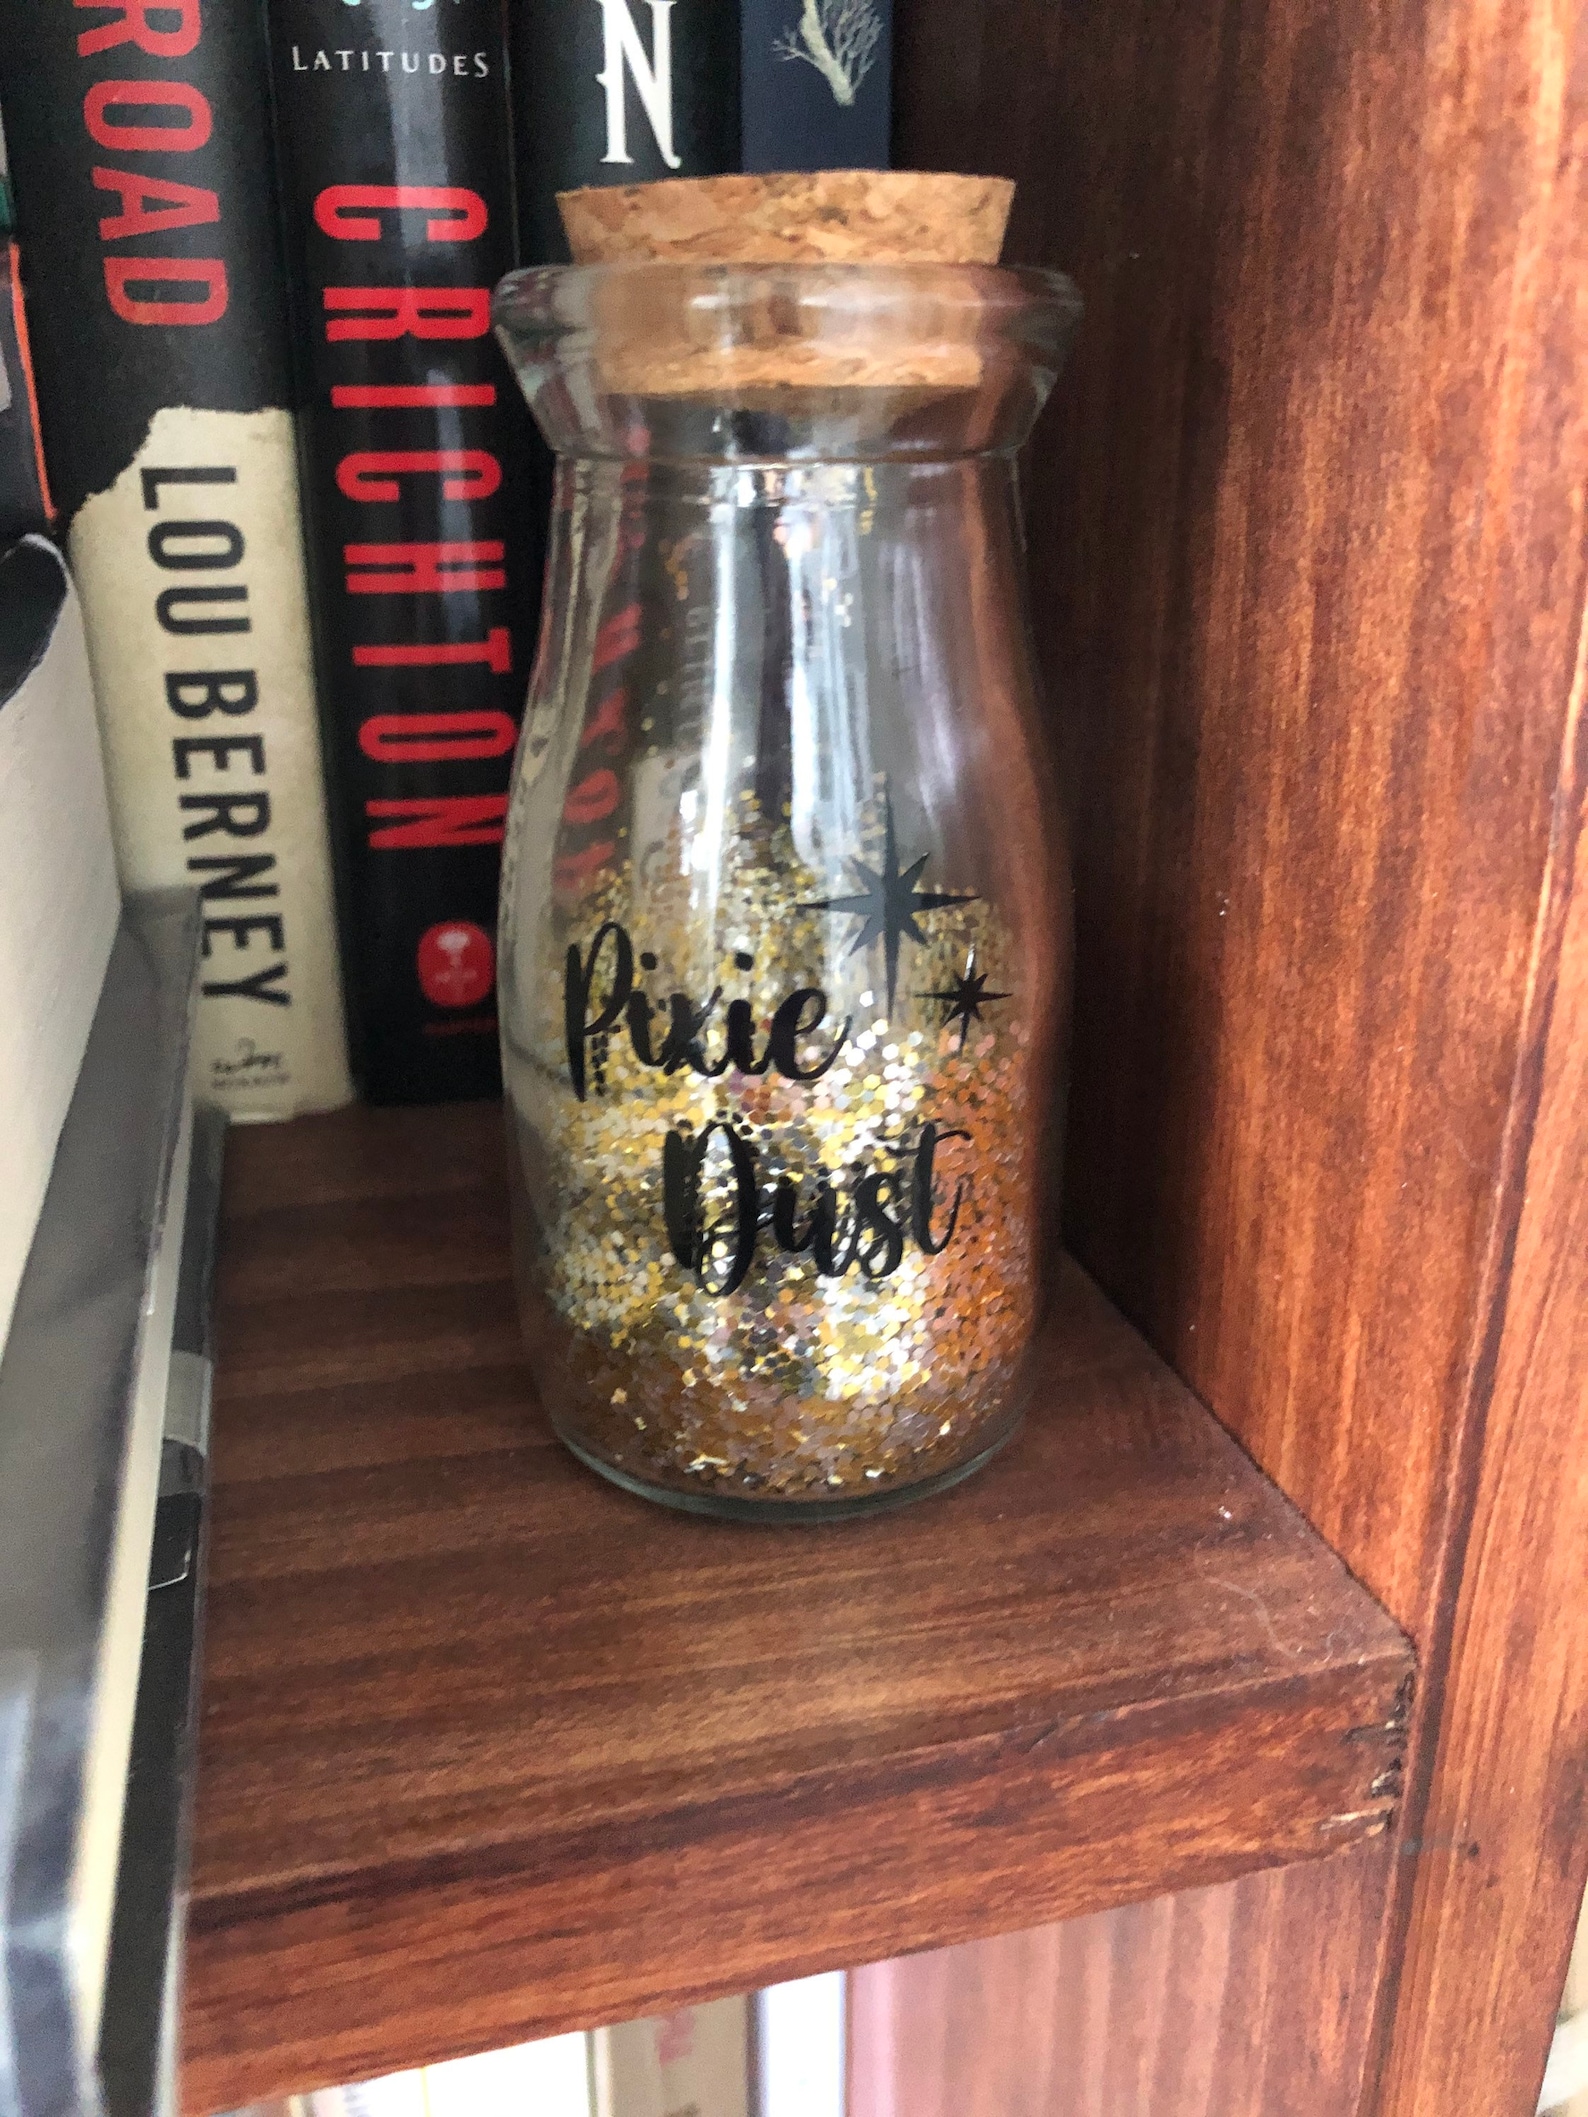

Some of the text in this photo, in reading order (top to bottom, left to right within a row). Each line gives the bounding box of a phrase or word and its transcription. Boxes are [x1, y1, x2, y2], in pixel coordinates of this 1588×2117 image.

[291, 45, 489, 78] LATITUDES
[73, 0, 230, 326] ROAD
[140, 465, 253, 636] LOU
[313, 184, 518, 848] CRICHTON
[164, 668, 291, 1008] BERNEY
[563, 921, 852, 1102] Pixie
[662, 1121, 972, 1297] Dust
